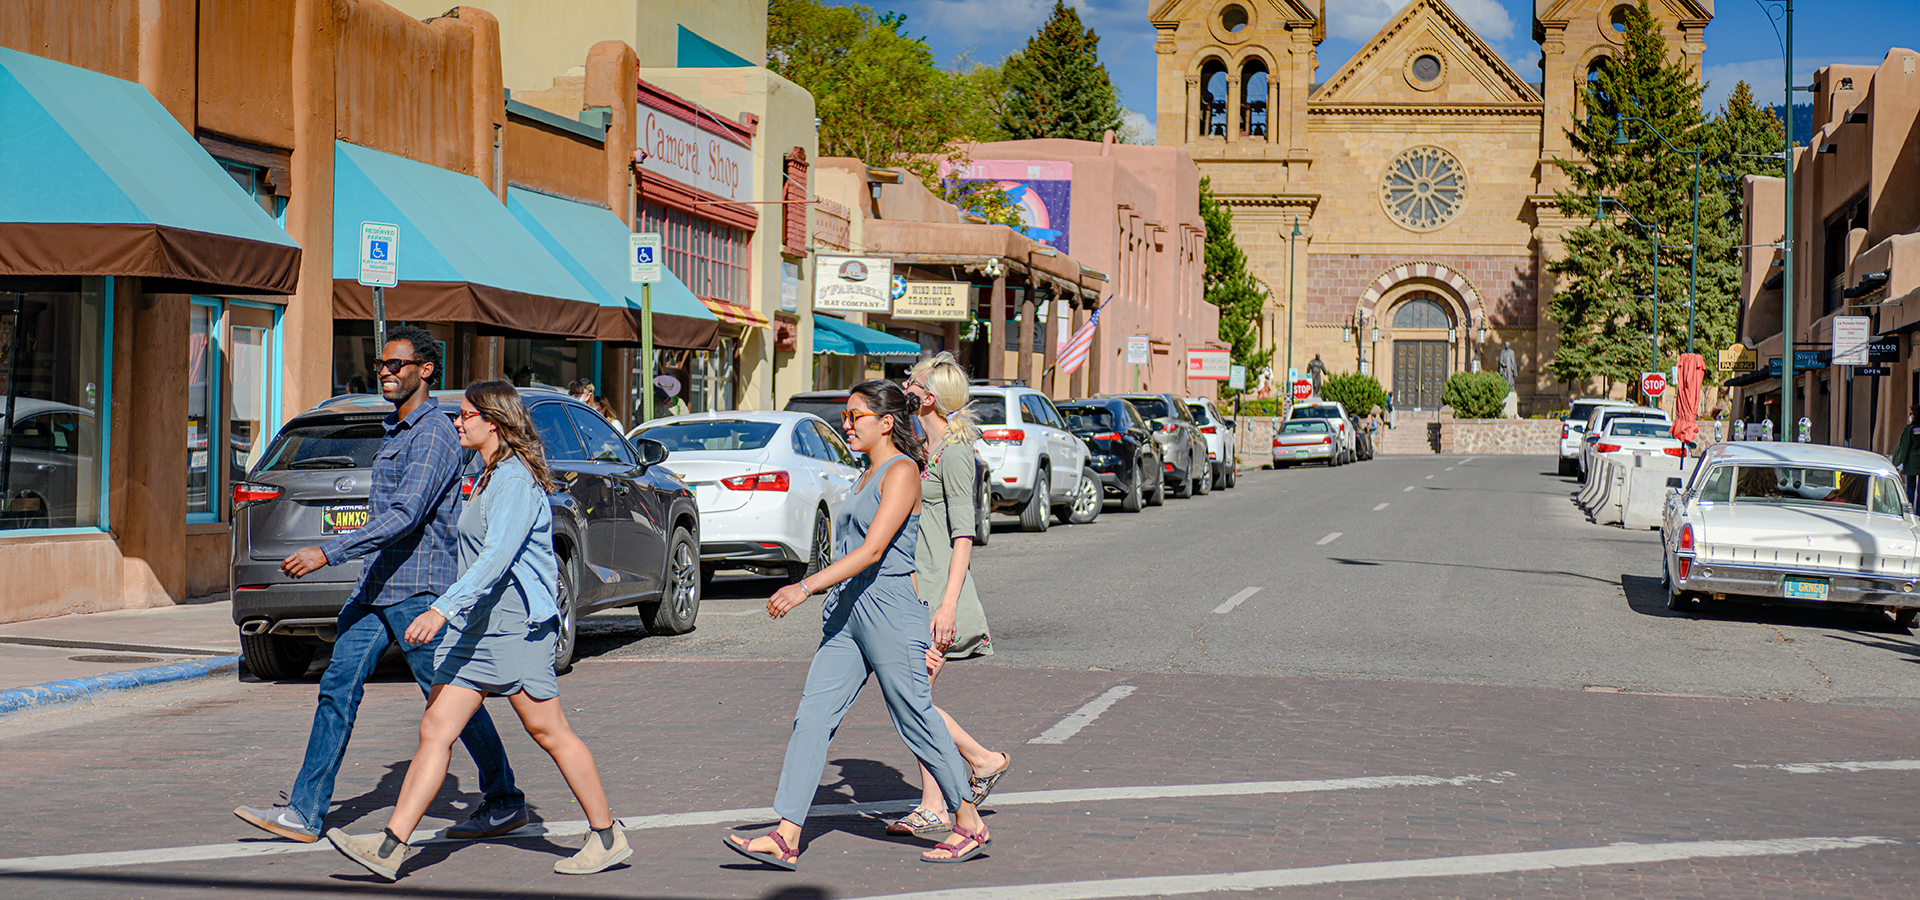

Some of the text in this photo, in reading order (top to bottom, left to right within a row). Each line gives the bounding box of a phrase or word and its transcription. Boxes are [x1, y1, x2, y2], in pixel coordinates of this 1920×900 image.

[645, 112, 739, 199] Camera Shop
[365, 228, 395, 236] RESERVED
[367, 234, 392, 242] PARKING
[819, 284, 886, 302] O'FARRELL
[912, 286, 952, 296] WIND RIVER
[841, 300, 880, 308] COMPANY
[908, 296, 955, 307] TRADING CO
[942, 309, 965, 317] POTTERY
[1294, 384, 1312, 395] STOP
[1644, 380, 1665, 390] STOP
[336, 512, 369, 526] AWMX9
[1789, 581, 1824, 593] L GRNGO
